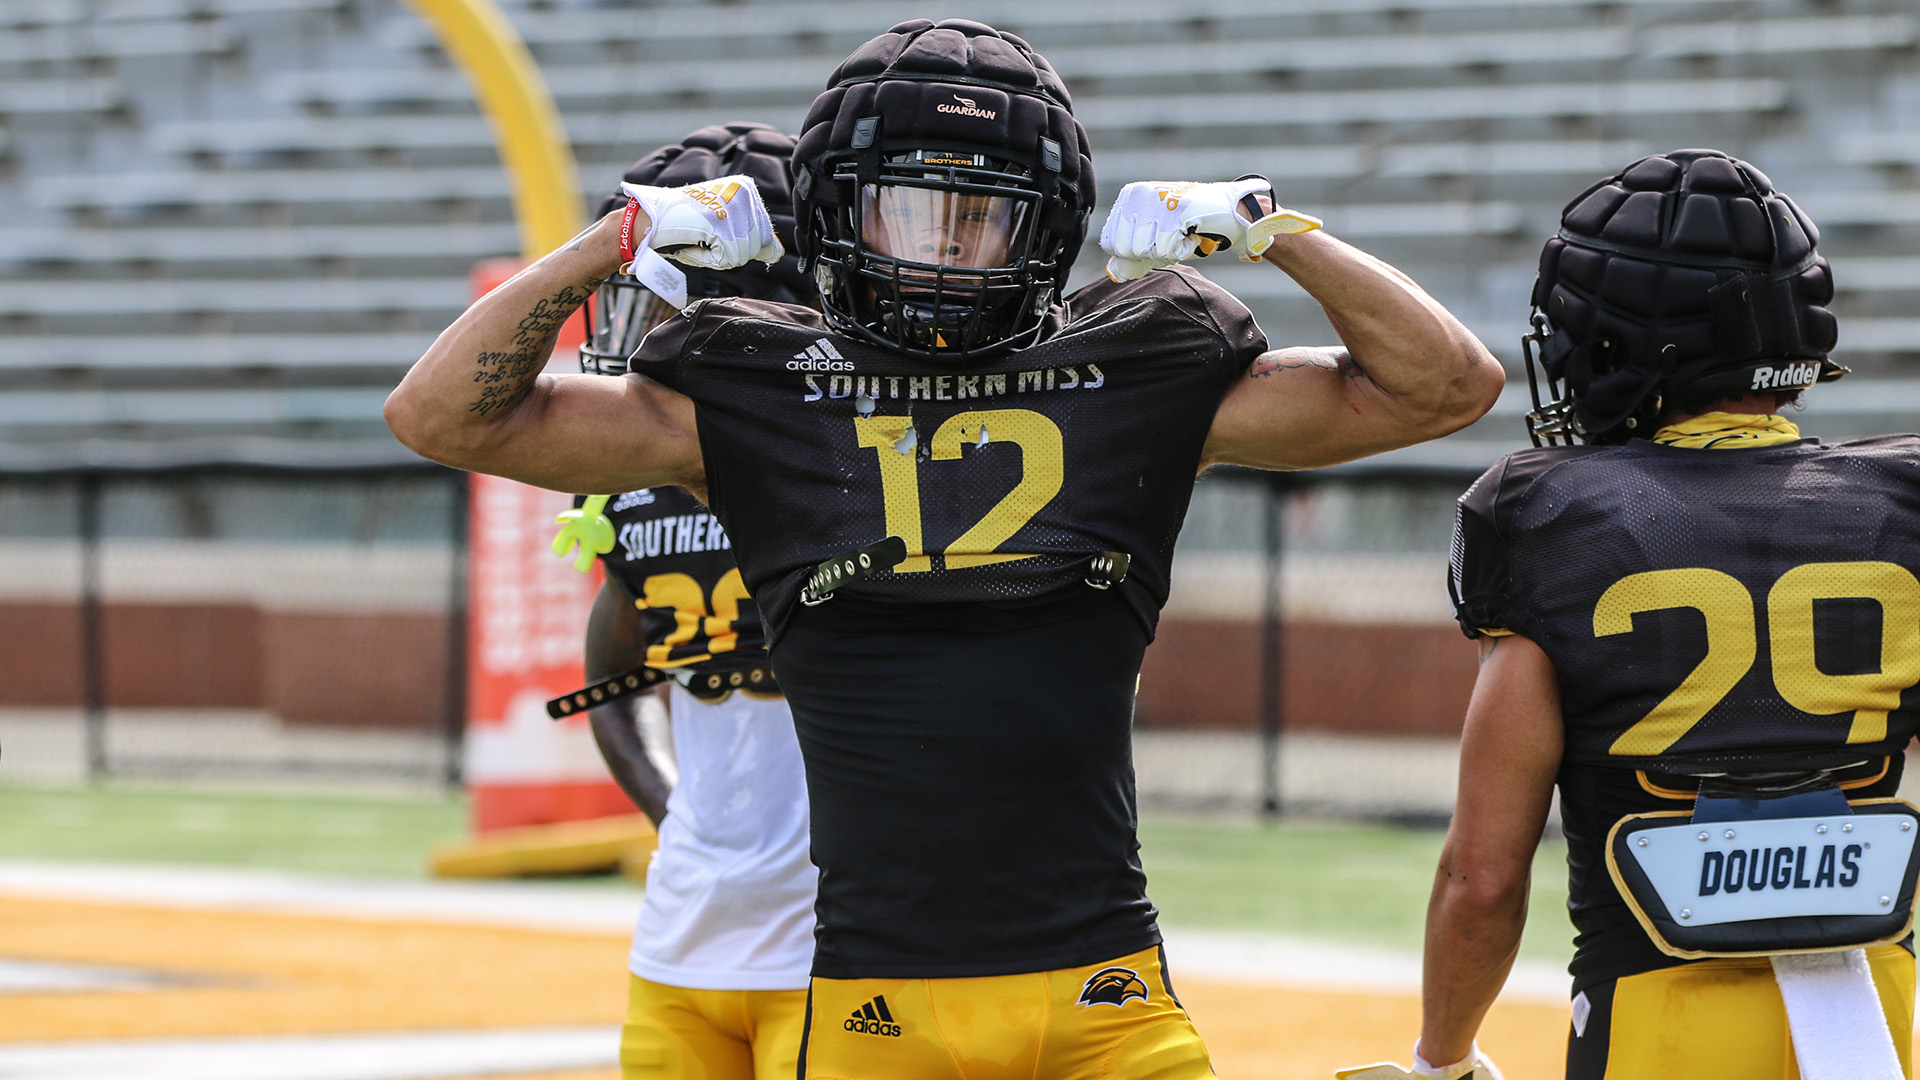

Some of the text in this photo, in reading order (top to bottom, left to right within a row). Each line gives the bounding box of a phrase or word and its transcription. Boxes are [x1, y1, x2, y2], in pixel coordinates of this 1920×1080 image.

[937, 104, 996, 120] GUARDIAN
[924, 158, 973, 166] BROTHERS
[682, 185, 728, 220] adidas
[620, 208, 634, 251] Letcher
[785, 357, 855, 372] adidas
[1751, 362, 1821, 390] Riddell
[804, 363, 1105, 402] SOUTHERN MISS
[853, 408, 1064, 575] 12
[1592, 561, 1920, 756] 29
[843, 1016, 902, 1037] adidas
